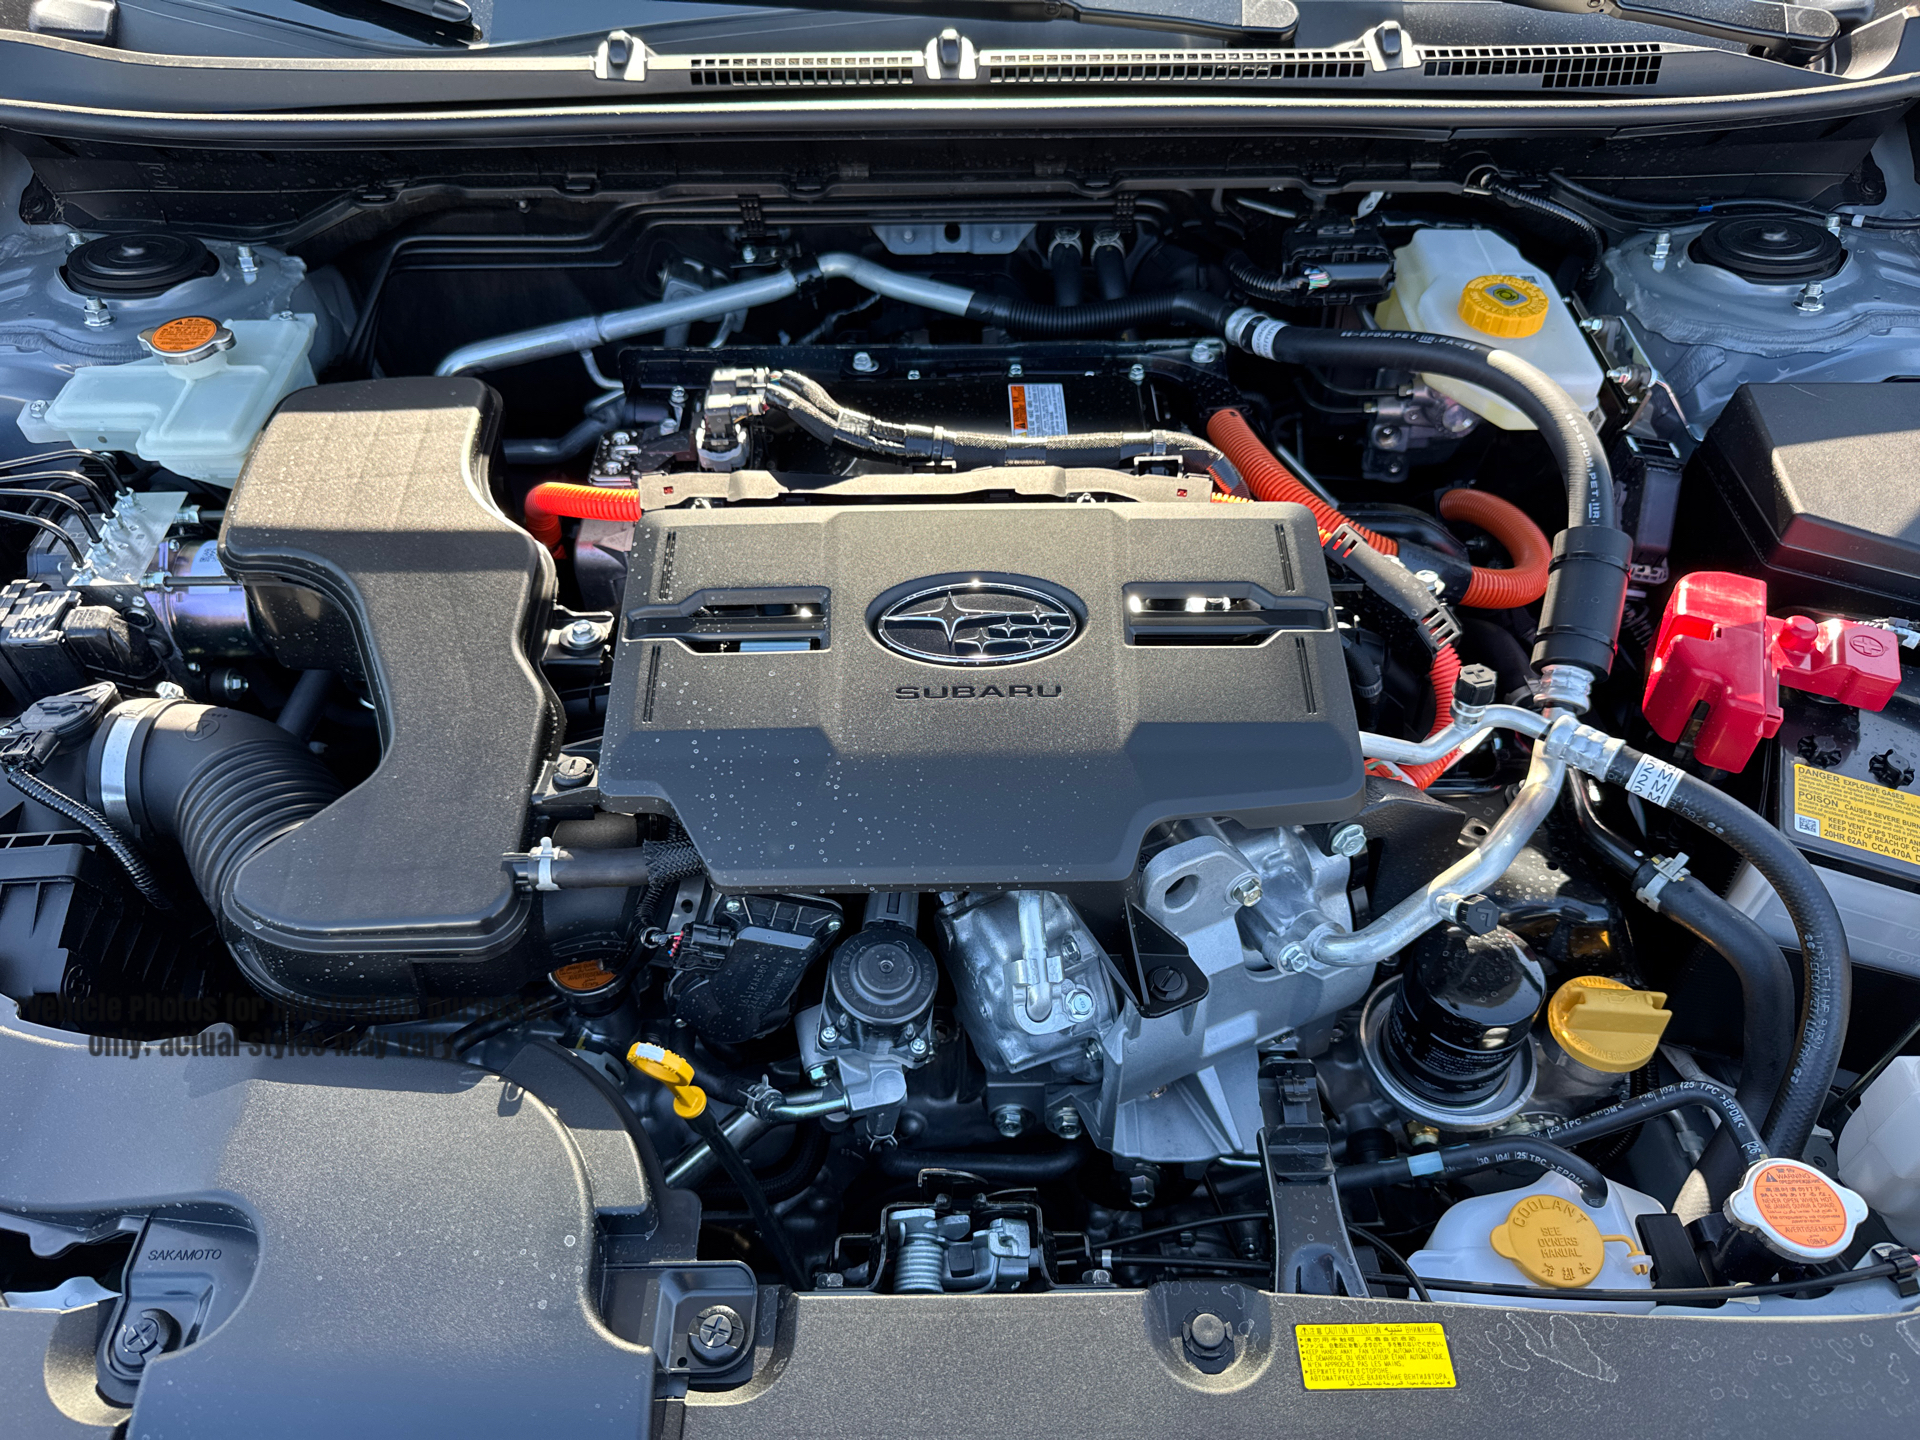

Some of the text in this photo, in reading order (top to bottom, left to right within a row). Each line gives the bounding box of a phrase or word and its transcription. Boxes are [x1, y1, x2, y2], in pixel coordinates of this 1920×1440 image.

[895, 685, 1062, 700] SUBARU
[1644, 763, 1654, 774] 2
[1658, 769, 1673, 782] M
[1637, 774, 1648, 786] 2
[1651, 780, 1667, 794] M
[1798, 767, 1904, 800] DANGER EXPLOSIVE GASES
[1798, 791, 1838, 807] POISON
[1844, 804, 1871, 816] CAUSES
[1873, 812, 1900, 823] SEVERE
[1828, 817, 1906, 842] KEEP VENT CAPS TIGHT
[1828, 823, 1846, 833] KEEP
[1848, 829, 1861, 837] OUT
[1875, 836, 1898, 847] REACH
[1824, 830, 1911, 859] 20HR 62Ah CCA 470A
[1700, 1082, 1720, 1095] TPC
[1529, 1154, 1547, 1166] TPC
[1512, 1198, 1588, 1228] COOLANT
[1540, 1227, 1562, 1236] SEE
[148, 1248, 222, 1261] SAKAMOTO
[1540, 1248, 1583, 1259] MANUAL
[1352, 1326, 1381, 1334] ATTENTION
